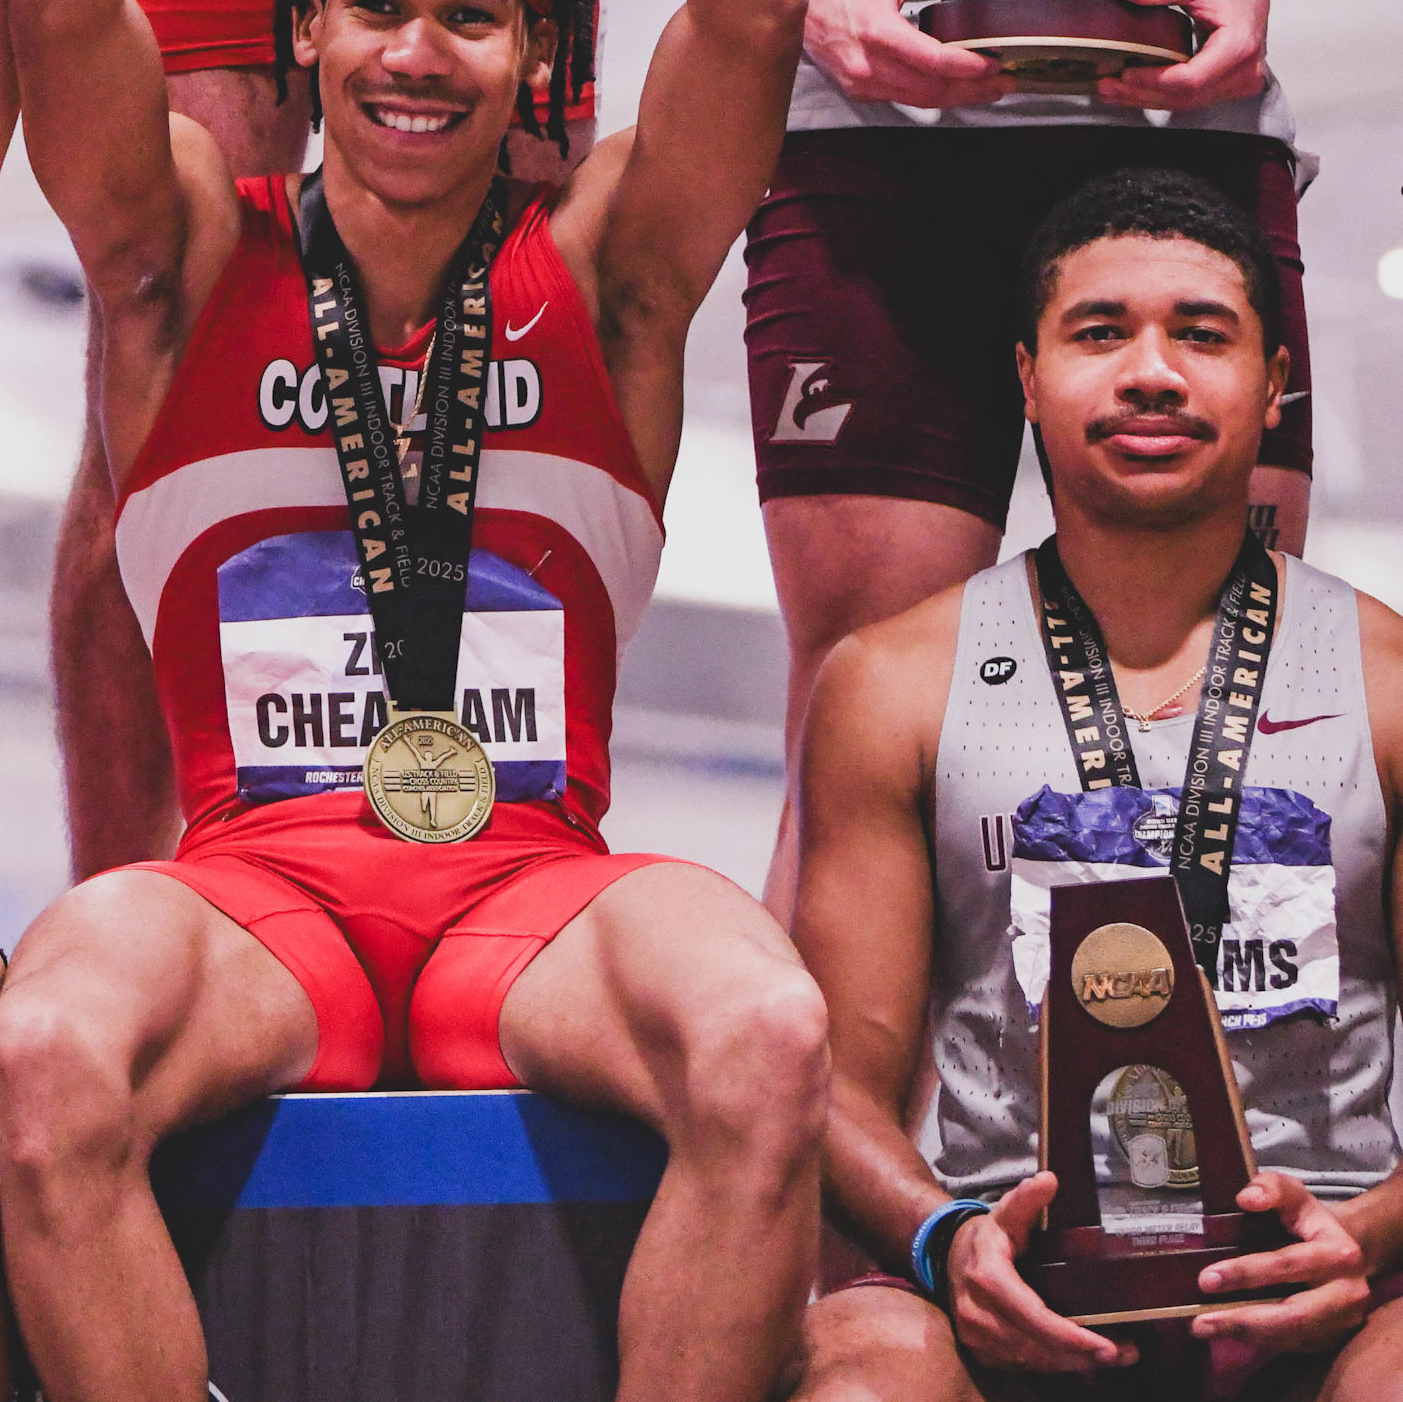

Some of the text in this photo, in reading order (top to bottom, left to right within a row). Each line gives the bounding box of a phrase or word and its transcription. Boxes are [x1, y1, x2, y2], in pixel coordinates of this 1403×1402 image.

[438, 362, 452, 381] III
[334, 262, 405, 540] NCAA DIVISION III INDOOR TRACK &
[431, 385, 451, 459] DIVISION
[312, 277, 395, 595] ALL-AMERICAN
[426, 461, 443, 510] NCAA
[417, 557, 465, 582] 2025
[1216, 618, 1237, 662] TRACK
[984, 660, 1014, 678] DF
[1094, 681, 1110, 696] III
[1204, 661, 1227, 727] INDOOR
[255, 687, 539, 749] CHEAAM
[381, 718, 477, 752] ALL-AMERICAN
[1099, 697, 1127, 762] INDOOR
[1199, 580, 1272, 876] ALL-AMERICAN
[1199, 727, 1214, 743] III
[409, 777, 458, 786] CROSS COUNTRY
[1184, 745, 1211, 817] DIVISION
[376, 796, 409, 833] DIVISION
[423, 829, 462, 841] INDOOR
[462, 806, 485, 831] TRACK
[1177, 820, 1198, 871] NCAA
[1082, 969, 1172, 1000] NCAA
